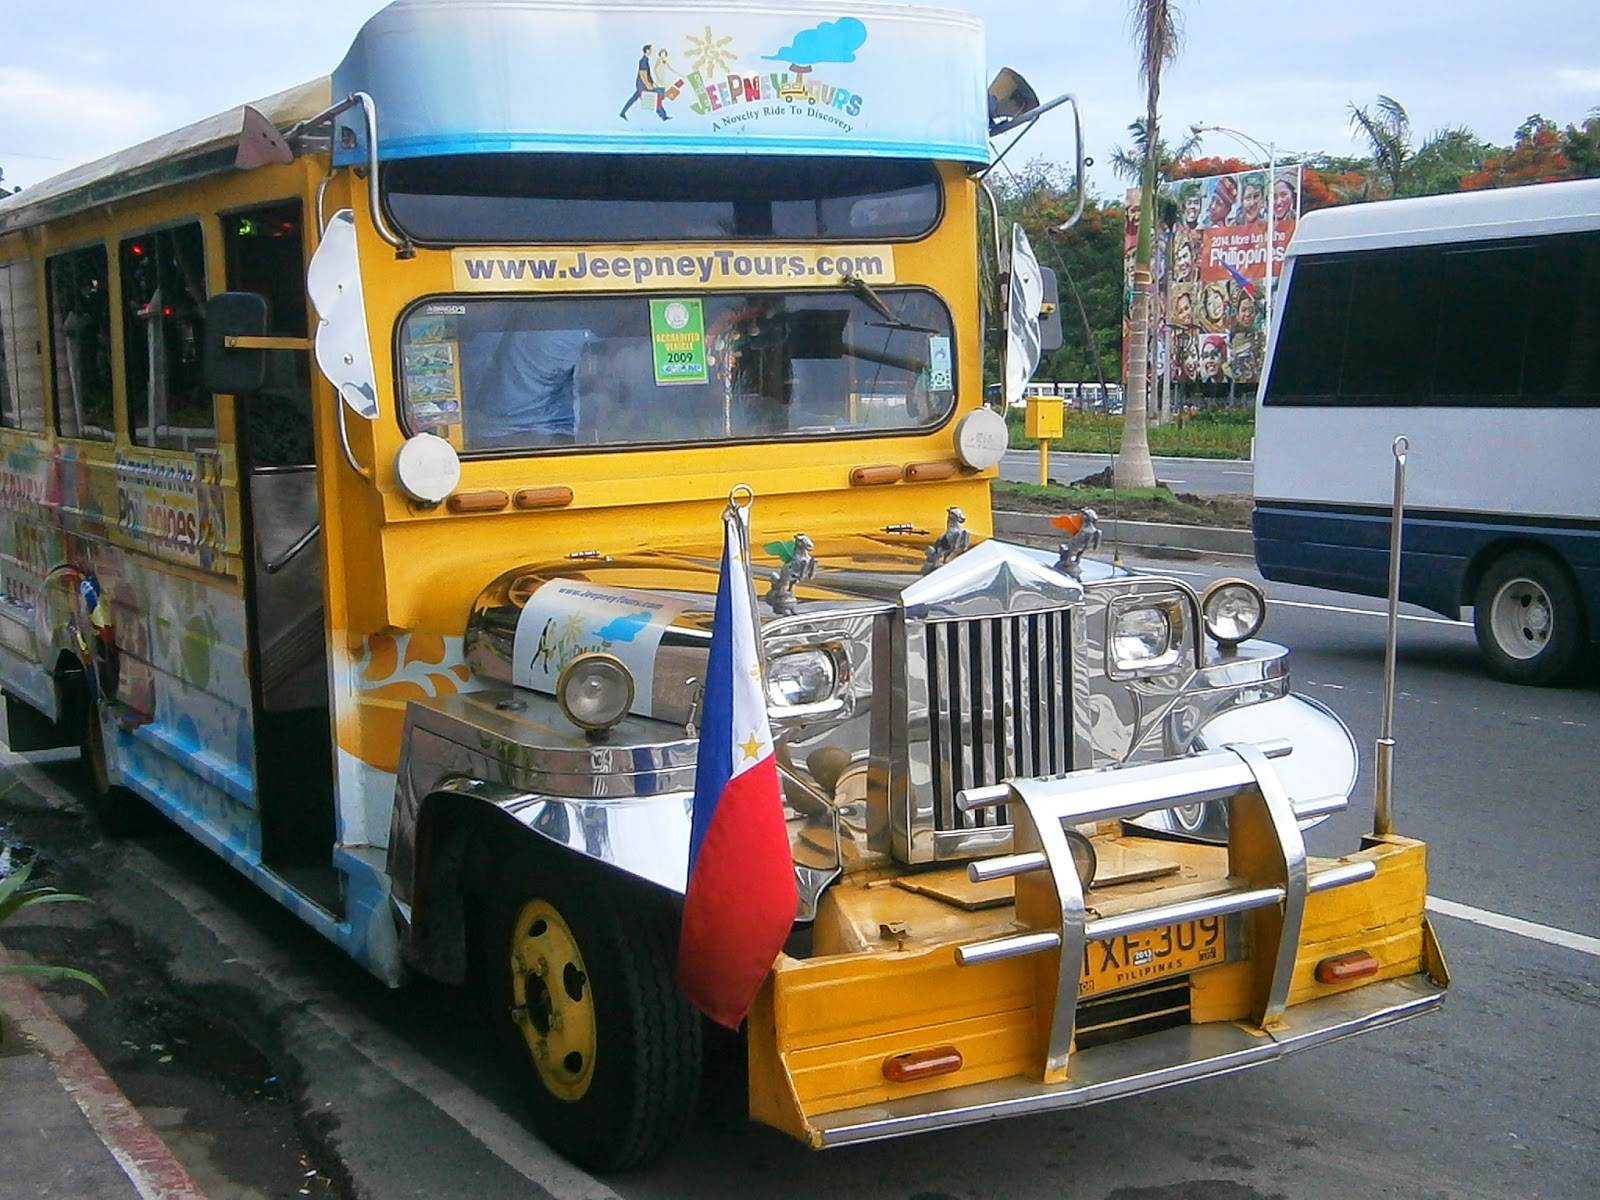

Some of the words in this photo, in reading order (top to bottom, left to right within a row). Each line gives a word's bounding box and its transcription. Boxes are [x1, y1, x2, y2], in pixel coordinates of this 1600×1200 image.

[712, 122, 721, 132] A
[721, 111, 759, 127] Novelty
[763, 105, 786, 116] Ride
[790, 105, 803, 115] To
[807, 107, 854, 133] Discovery
[464, 250, 883, 284] www.JeepneyTours.com
[656, 332, 700, 342] ACCREDITED
[667, 353, 693, 363] 2009
[1116, 959, 1183, 982] PILIPINAS
